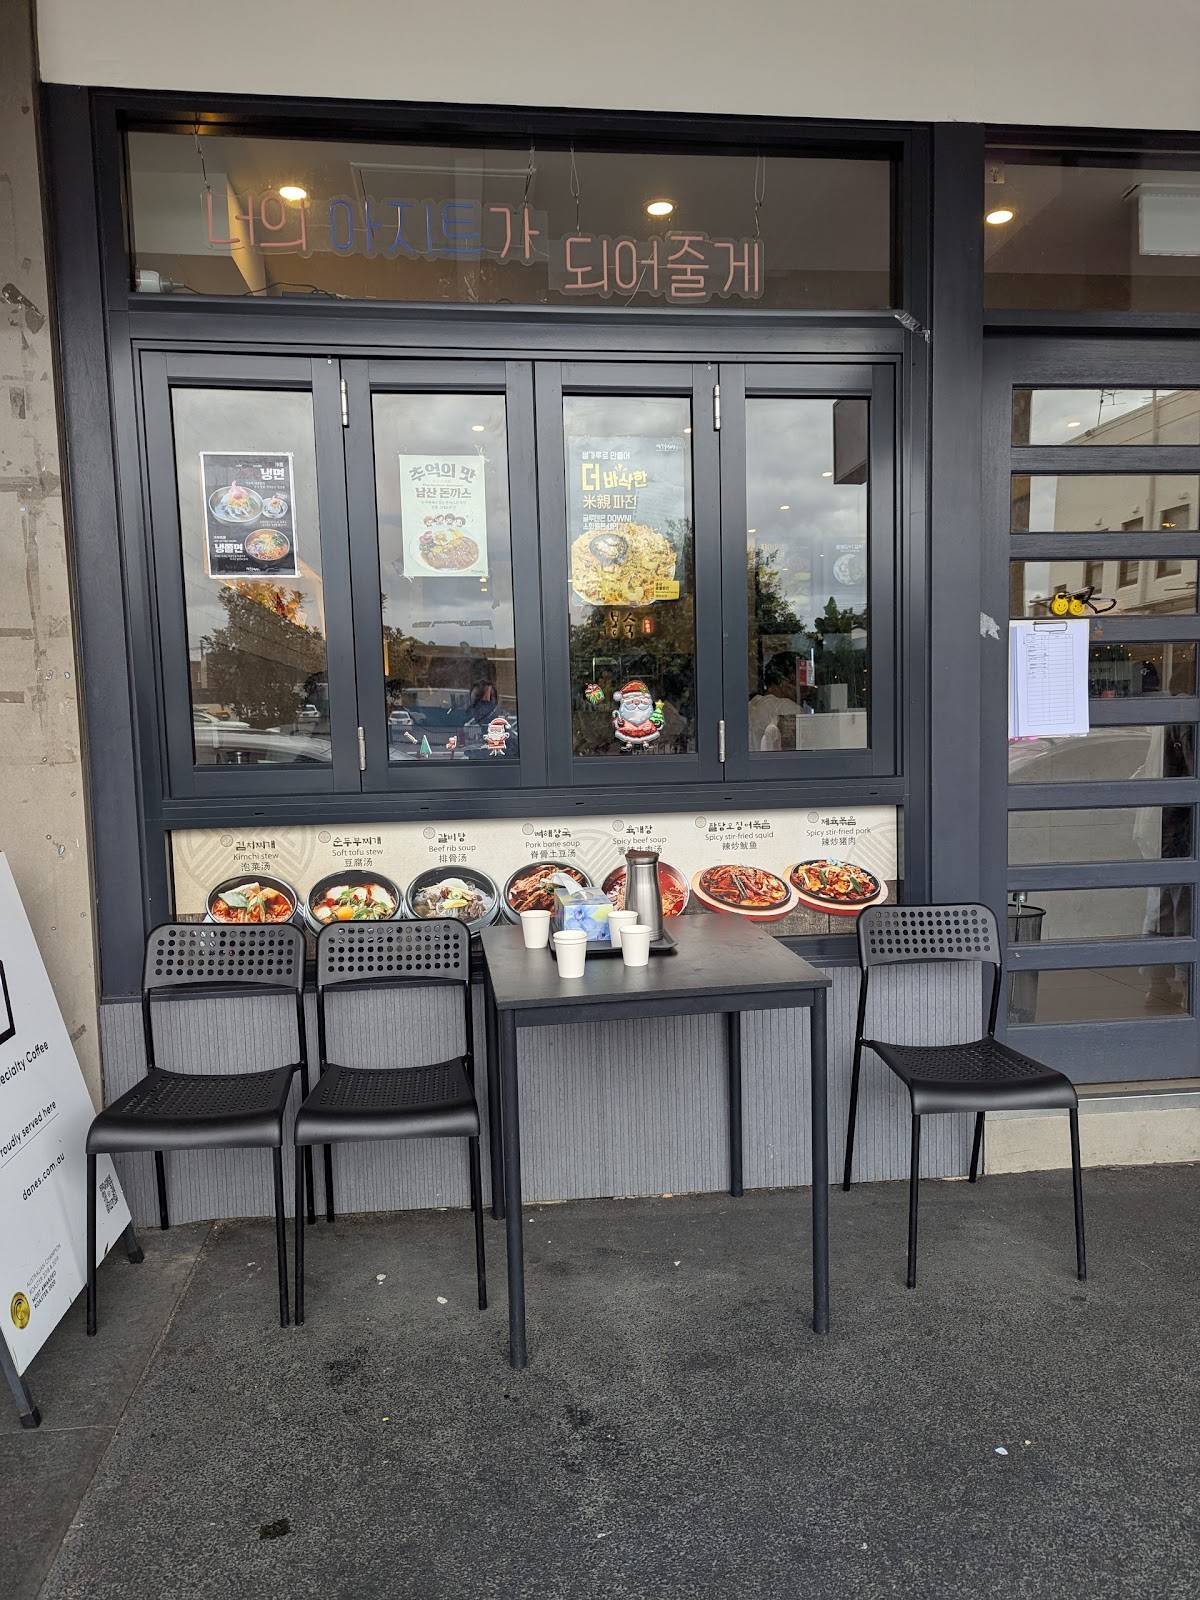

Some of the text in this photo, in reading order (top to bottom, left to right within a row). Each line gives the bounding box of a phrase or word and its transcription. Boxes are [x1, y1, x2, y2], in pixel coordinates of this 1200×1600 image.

[205, 191, 538, 259] 너의 아지트가
[565, 233, 761, 298] 되어줄게
[260, 468, 285, 480] 냉면
[409, 463, 476, 483] 추억의 맛
[581, 463, 648, 491] 더 바삭한
[415, 487, 472, 499] 남산 돈까스
[613, 495, 638, 509] 파전
[626, 824, 653, 835] 육개장
[806, 827, 872, 838] Spicy stir-fried pork
[333, 836, 382, 847] 순두부찌개
[438, 832, 466, 843] 갈비탕
[612, 836, 667, 846] Spicy beef soup
[705, 831, 774, 841] Spicy stir-fried squid
[235, 839, 276, 850] 김치찌개
[525, 840, 580, 849] Pork bone soup
[722, 841, 757, 851] 辣炒鱿鱼
[821, 837, 856, 847] 辣炒猪肉
[332, 848, 384, 857] Soft tofu stew
[429, 844, 476, 853] Beef rib soup
[233, 852, 279, 861] Kimchi stew
[439, 853, 467, 863] 排骨汤
[531, 849, 577, 860] 脊骨土豆汤
[240, 861, 271, 872] 泡菜汤
[344, 857, 373, 868] 豆腐汤
[0, 1040, 50, 1087] ecialty Coffee
[0, 1100, 57, 1158] roudly served here
[22, 1152, 66, 1201] danes.com.au
